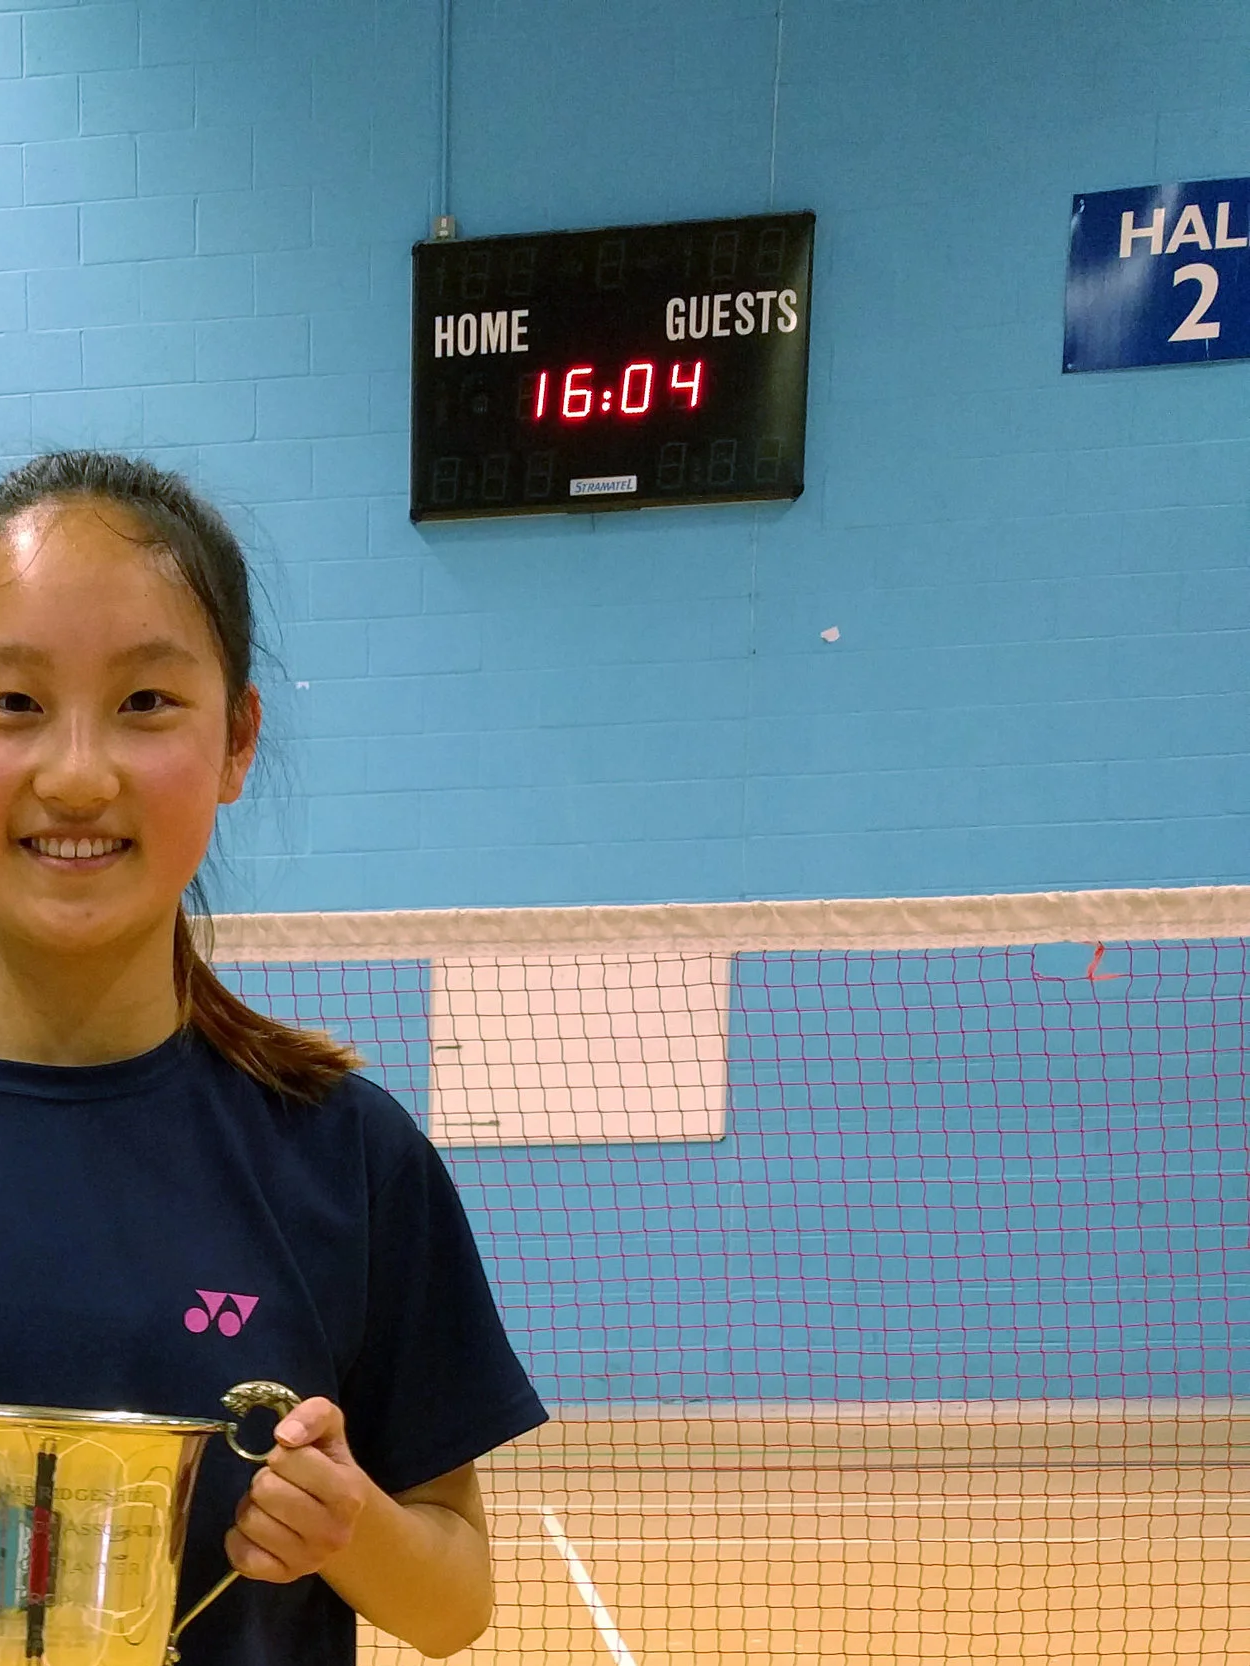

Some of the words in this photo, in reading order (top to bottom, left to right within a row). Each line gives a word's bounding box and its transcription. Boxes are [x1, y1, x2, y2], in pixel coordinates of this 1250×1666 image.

[1119, 201, 1250, 258] HAL
[666, 289, 797, 341] GUESTS
[1167, 263, 1221, 342] 2
[434, 310, 529, 358] HOME
[534, 361, 702, 418] 16:04
[575, 478, 633, 493] STRAMATEL
